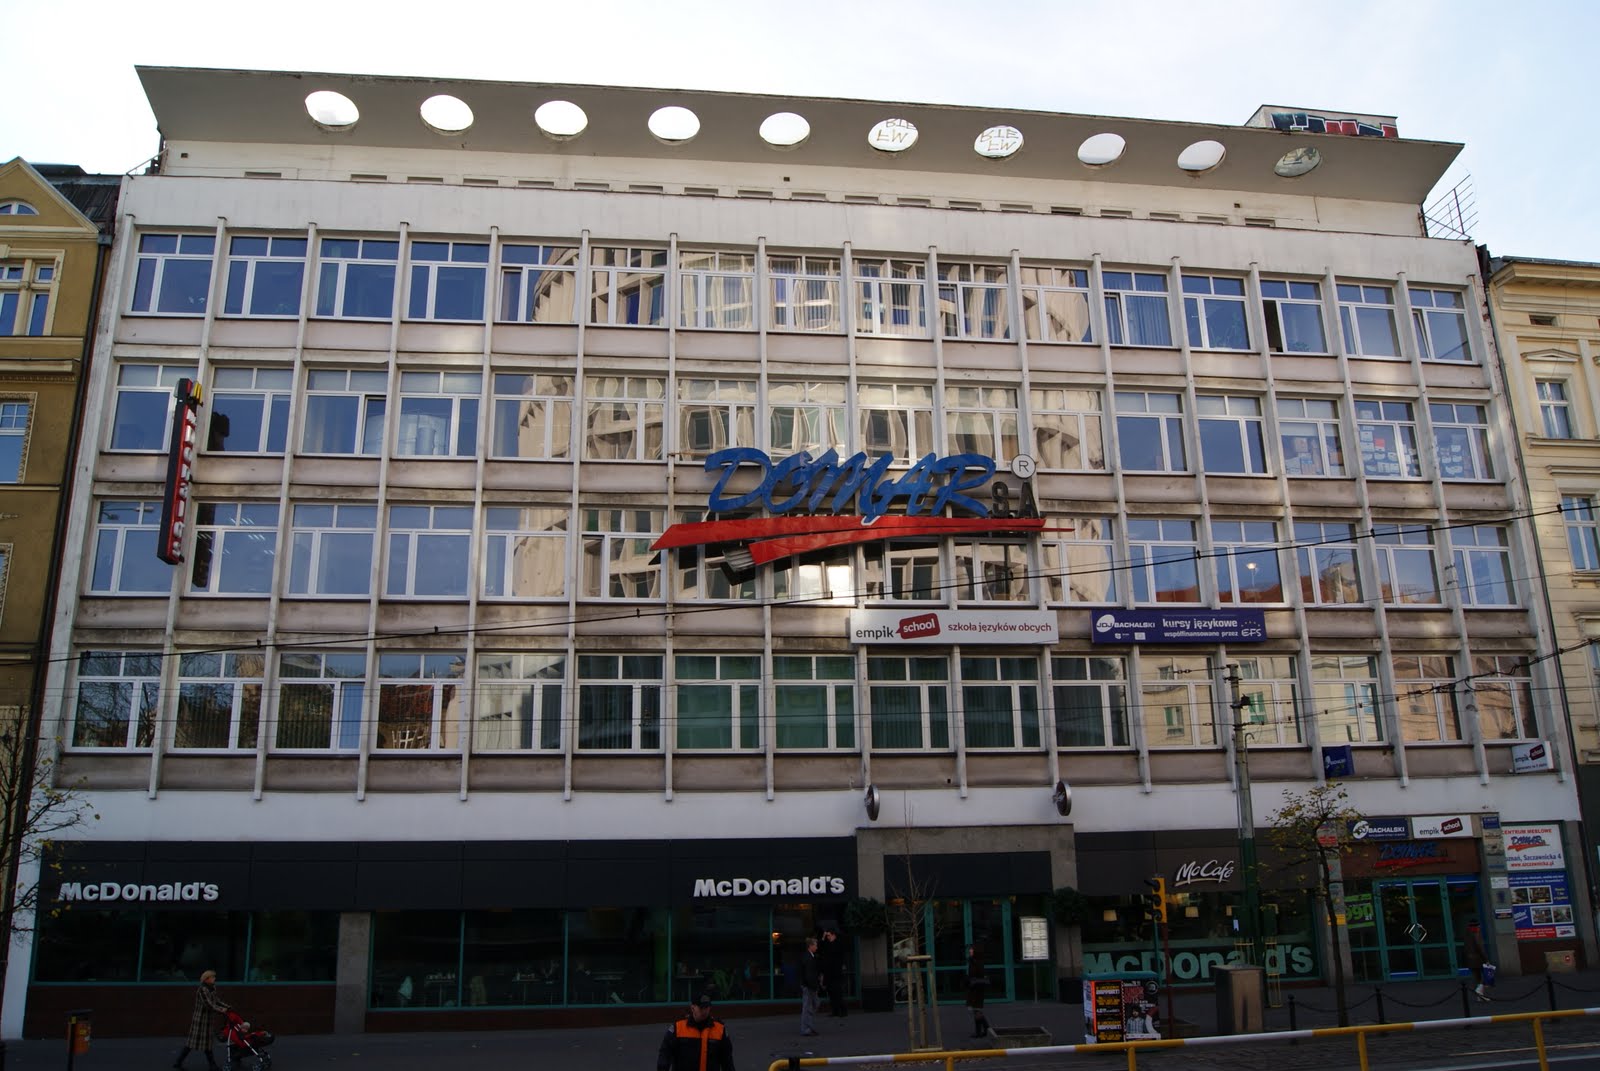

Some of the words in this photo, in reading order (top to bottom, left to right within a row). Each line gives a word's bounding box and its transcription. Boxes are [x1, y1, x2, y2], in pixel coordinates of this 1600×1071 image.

[704, 447, 997, 525] DOMAR
[855, 625, 894, 640] empik
[903, 618, 936, 633] school
[948, 622, 977, 631] szkoła
[978, 622, 1017, 633] języków
[1018, 623, 1052, 634] obcych
[1162, 618, 1191, 630] kursy
[1193, 618, 1238, 630] językowe
[1241, 628, 1262, 637] EFS
[1369, 826, 1405, 834] BACHALSKI
[1419, 826, 1440, 837] empik
[1443, 820, 1461, 832] school
[1175, 859, 1235, 885] McCafé
[58, 882, 219, 901] McDonald's
[692, 876, 846, 897] McDonald's
[1083, 944, 1314, 980] McDonad's
